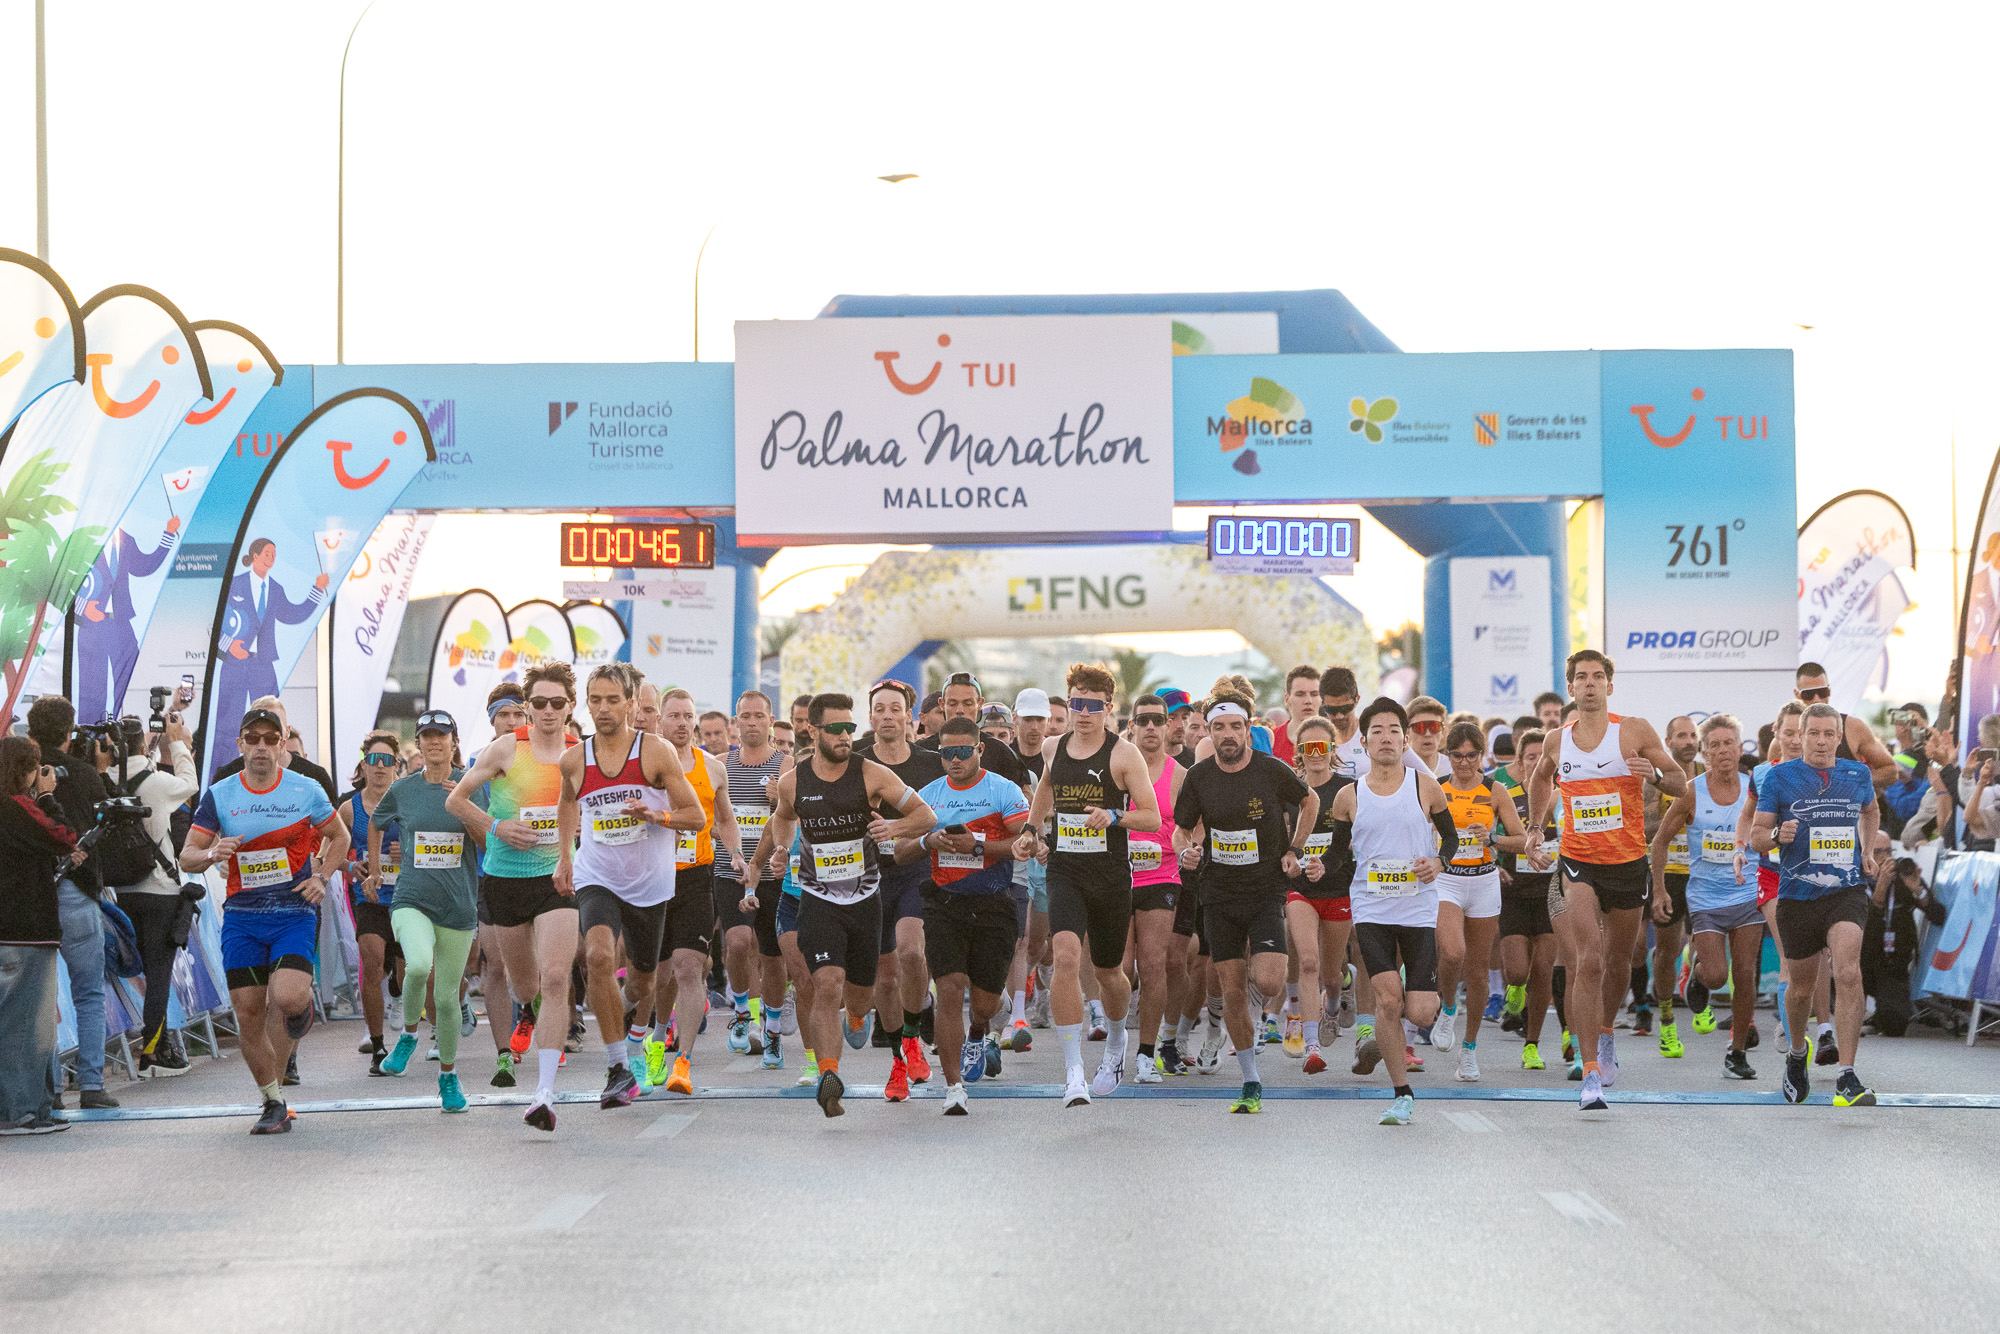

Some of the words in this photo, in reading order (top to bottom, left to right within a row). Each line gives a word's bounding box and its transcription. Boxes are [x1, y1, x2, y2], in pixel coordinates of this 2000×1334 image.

[962, 363, 1016, 387] TUI
[590, 401, 673, 418] Fundació
[1207, 416, 1312, 436] Mallorca
[1507, 415, 1549, 427] Govern
[1552, 414, 1566, 425] de
[1569, 414, 1587, 425] les
[590, 421, 668, 437] Mallorca
[1715, 416, 1768, 440] TUI
[760, 410, 907, 470] Palma
[919, 402, 1150, 475] Marathon
[1392, 434, 1449, 443] Sostenibles
[1507, 430, 1532, 441] Illes
[1537, 429, 1581, 440] Balears
[1277, 438, 1312, 446] Balears
[588, 442, 664, 458] Turisme
[884, 487, 1028, 508] MALLORCA
[1215, 519, 1352, 558] 00:00:00
[176, 554, 218, 563] Ajuntament
[176, 563, 186, 571] de
[187, 563, 212, 571] Palma
[397, 530, 428, 602] MALLORCA
[355, 581, 392, 656] Palma
[379, 513, 419, 575] Mara
[622, 585, 646, 596] 10K
[1049, 574, 1146, 610] FNG
[1626, 630, 1697, 649] PROA
[1699, 629, 1780, 649] GROUP
[443, 642, 496, 661] Mallorca
[1704, 651, 1746, 659] DREAMS
[586, 789, 643, 807] GATESHEAD
[1581, 807, 1611, 819] 8511
[1812, 811, 1845, 819] SPORTING
[598, 816, 639, 830] 10358
[736, 816, 762, 825] 9147
[802, 813, 864, 828] PEGASUS
[1063, 827, 1099, 837] 10413
[424, 845, 454, 854] 9364
[1218, 842, 1248, 852] 8770
[1817, 840, 1851, 849] 10360
[823, 854, 855, 867] 9295
[248, 861, 279, 874] 9258
[1446, 865, 1477, 875] NIKE
[1377, 873, 1408, 882] 9785
